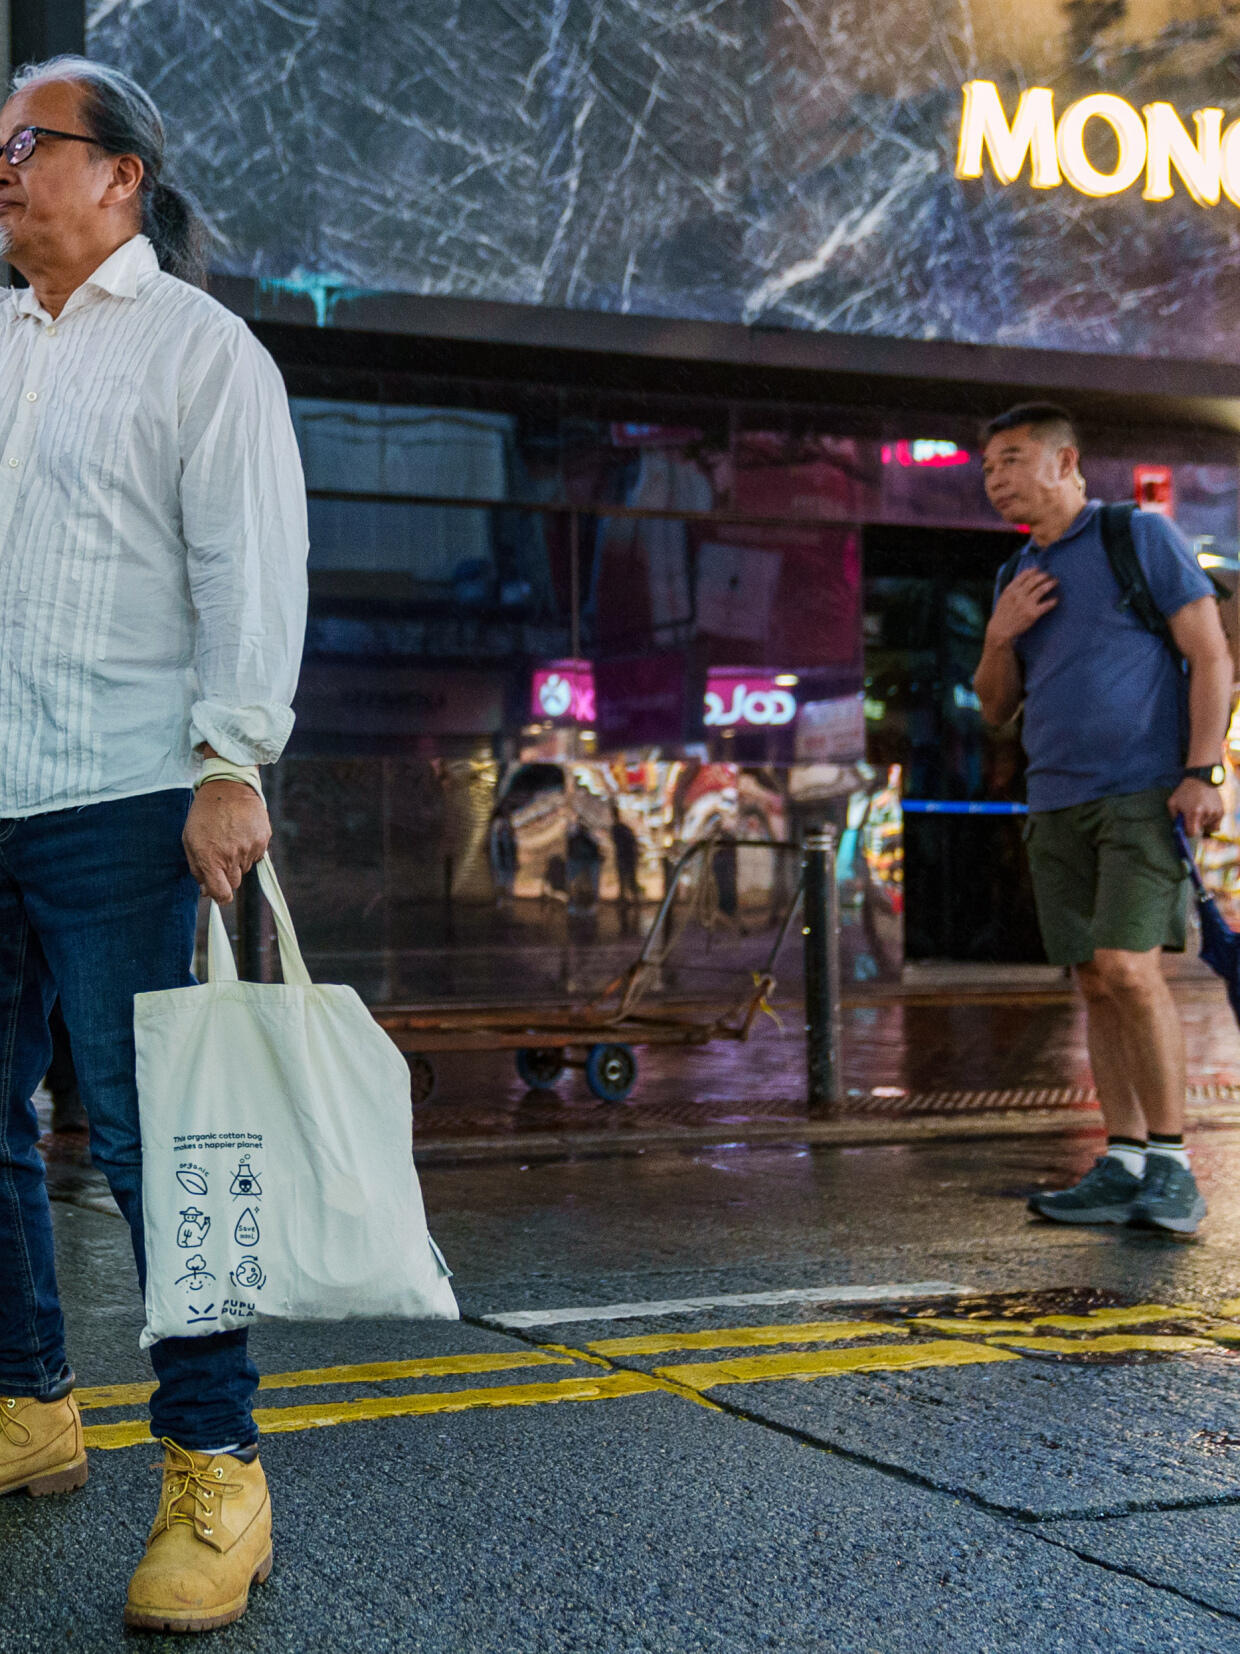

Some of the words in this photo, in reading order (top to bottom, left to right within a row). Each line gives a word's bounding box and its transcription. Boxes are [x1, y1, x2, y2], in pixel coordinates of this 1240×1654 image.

[173, 1135, 186, 1143] This
[187, 1132, 217, 1142] organic
[218, 1132, 246, 1140] cotton
[247, 1132, 263, 1141] bag
[173, 1143, 196, 1152] makes
[204, 1141, 235, 1149] happier
[237, 1141, 263, 1149] planet
[179, 1162, 210, 1177] organic
[221, 1307, 255, 1317] PULA
